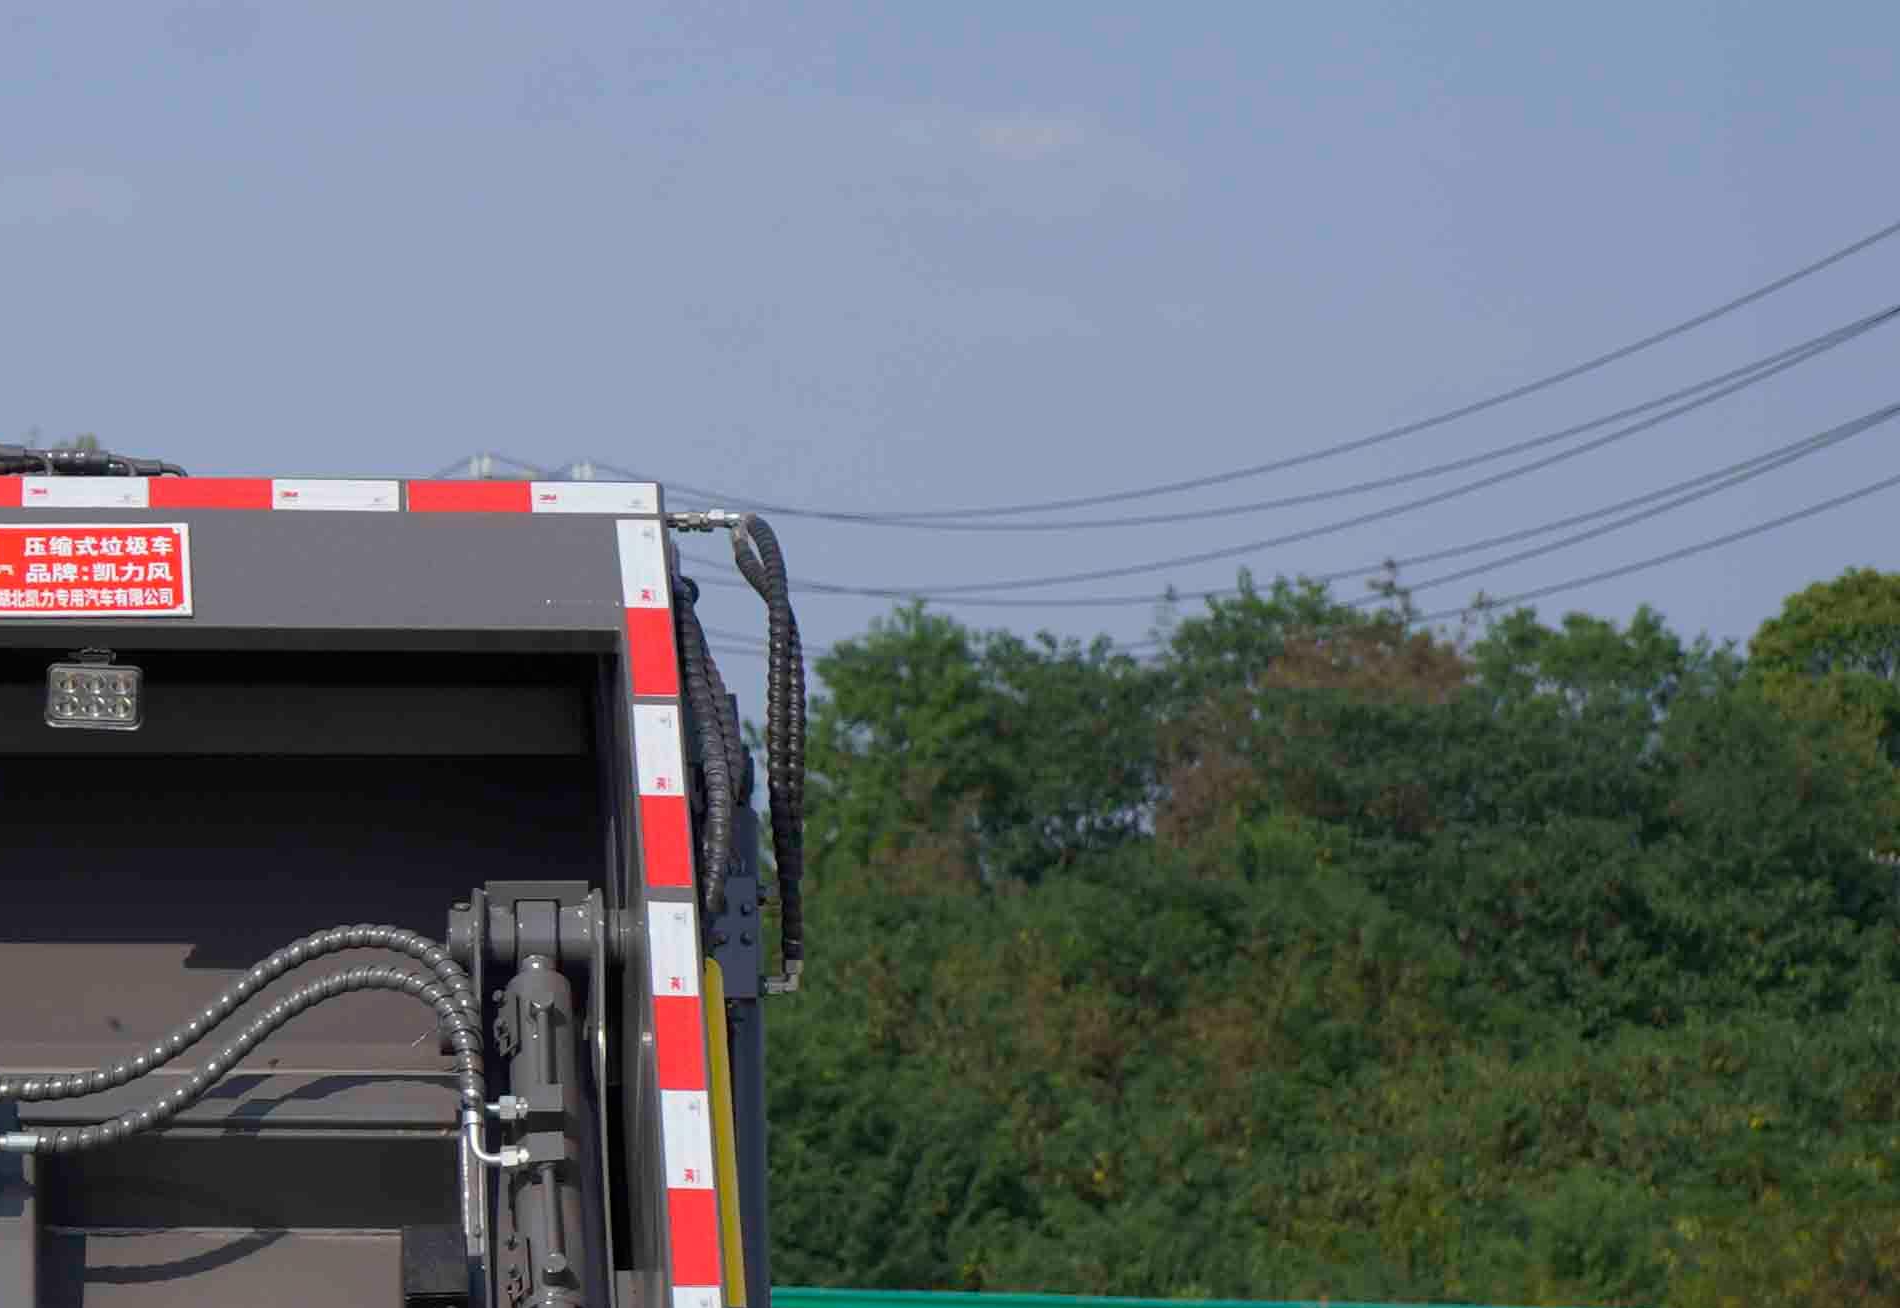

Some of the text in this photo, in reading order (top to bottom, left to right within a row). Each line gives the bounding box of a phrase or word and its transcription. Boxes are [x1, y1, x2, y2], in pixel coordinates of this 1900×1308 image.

[24, 536, 173, 557] 压缩式垃圾车
